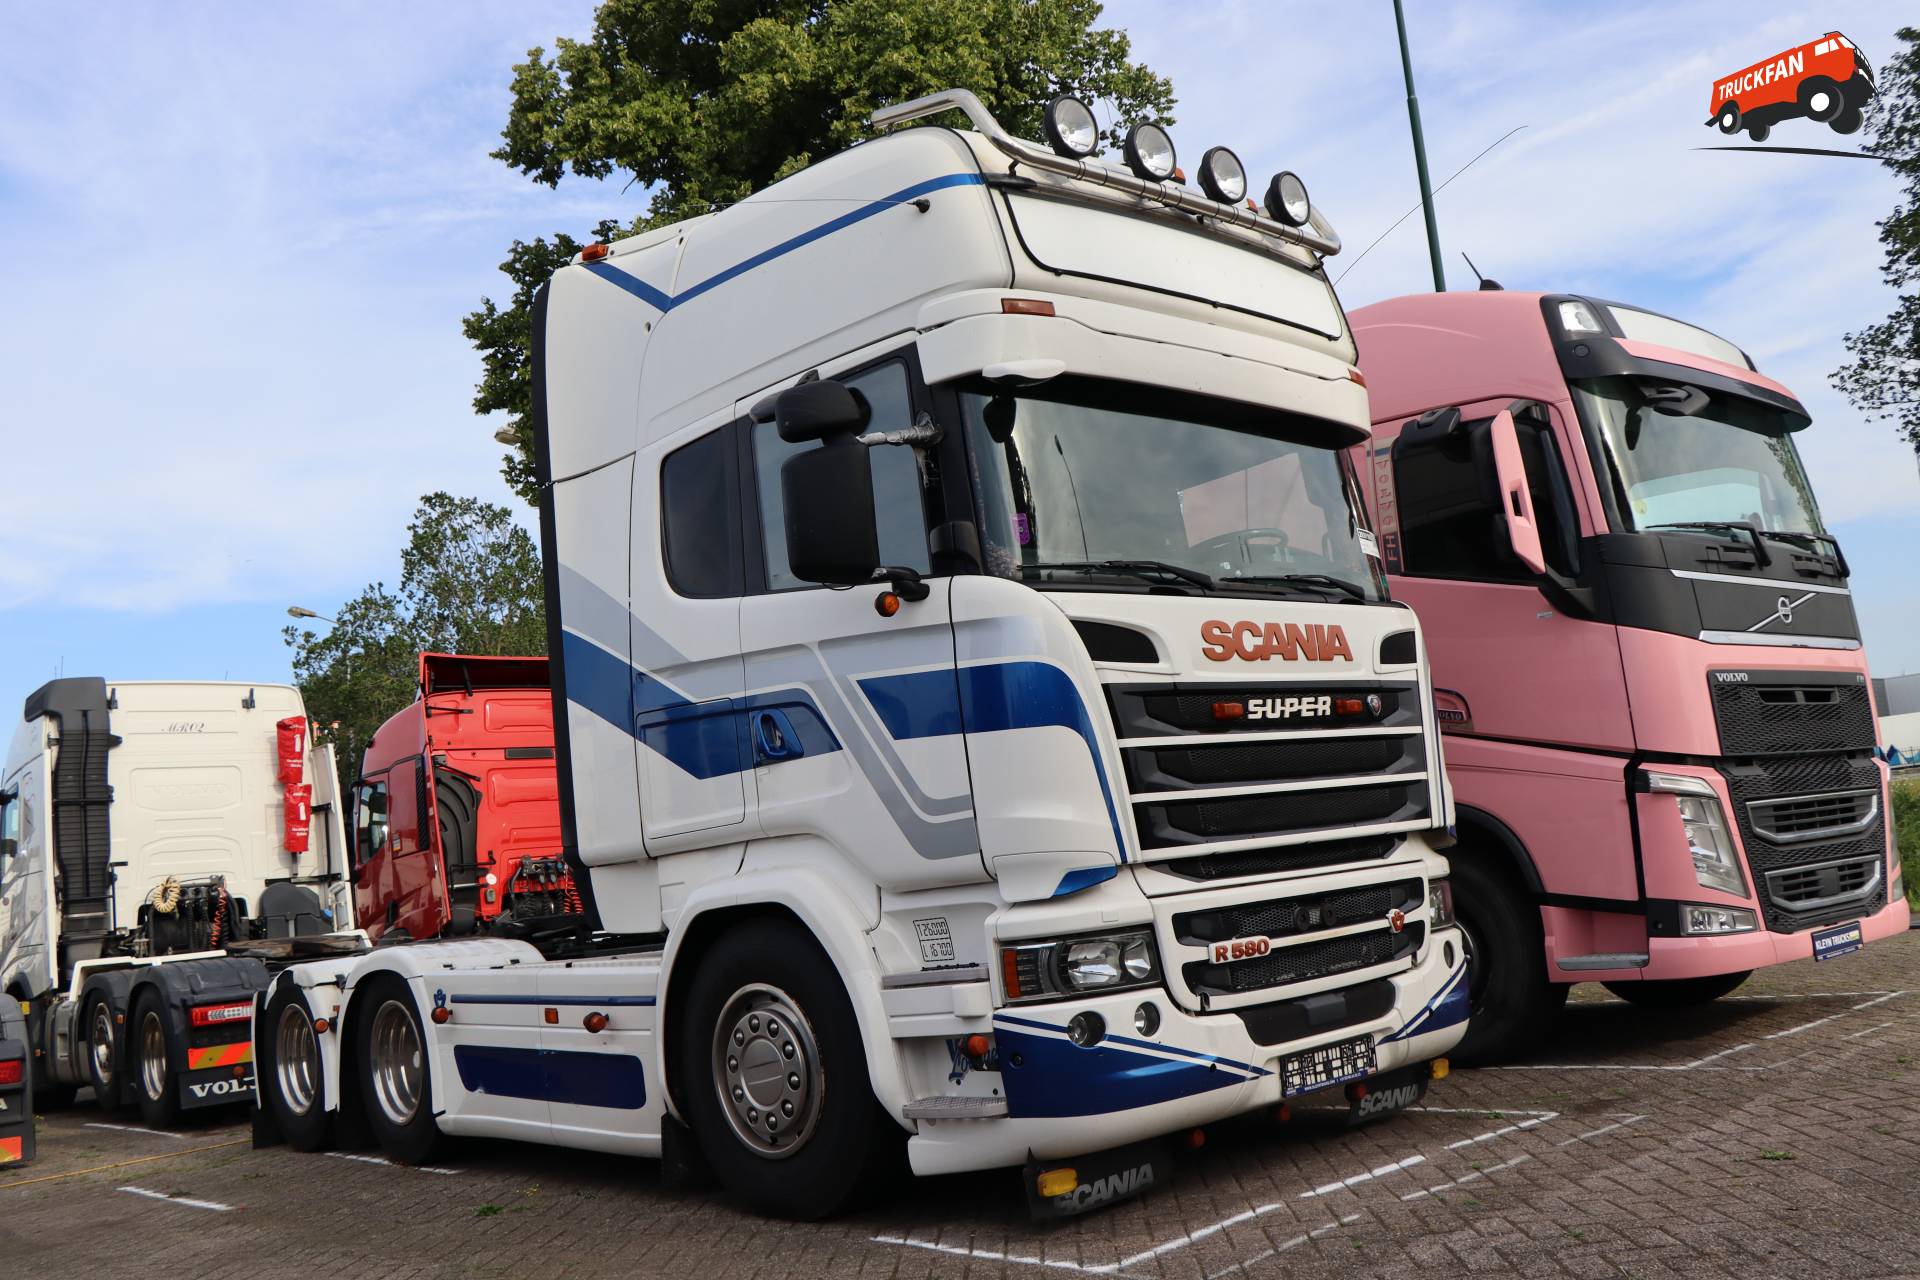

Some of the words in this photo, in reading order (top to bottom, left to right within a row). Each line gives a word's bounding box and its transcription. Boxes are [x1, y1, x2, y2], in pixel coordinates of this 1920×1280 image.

[1200, 619, 1353, 662] SCANIA
[1714, 672, 1749, 682] VOLVO
[1247, 695, 1331, 720] SUPER
[1215, 943, 1229, 963] R
[1231, 939, 1270, 960] 580
[189, 1076, 257, 1098] VOL
[1359, 1083, 1419, 1117] SCANIA
